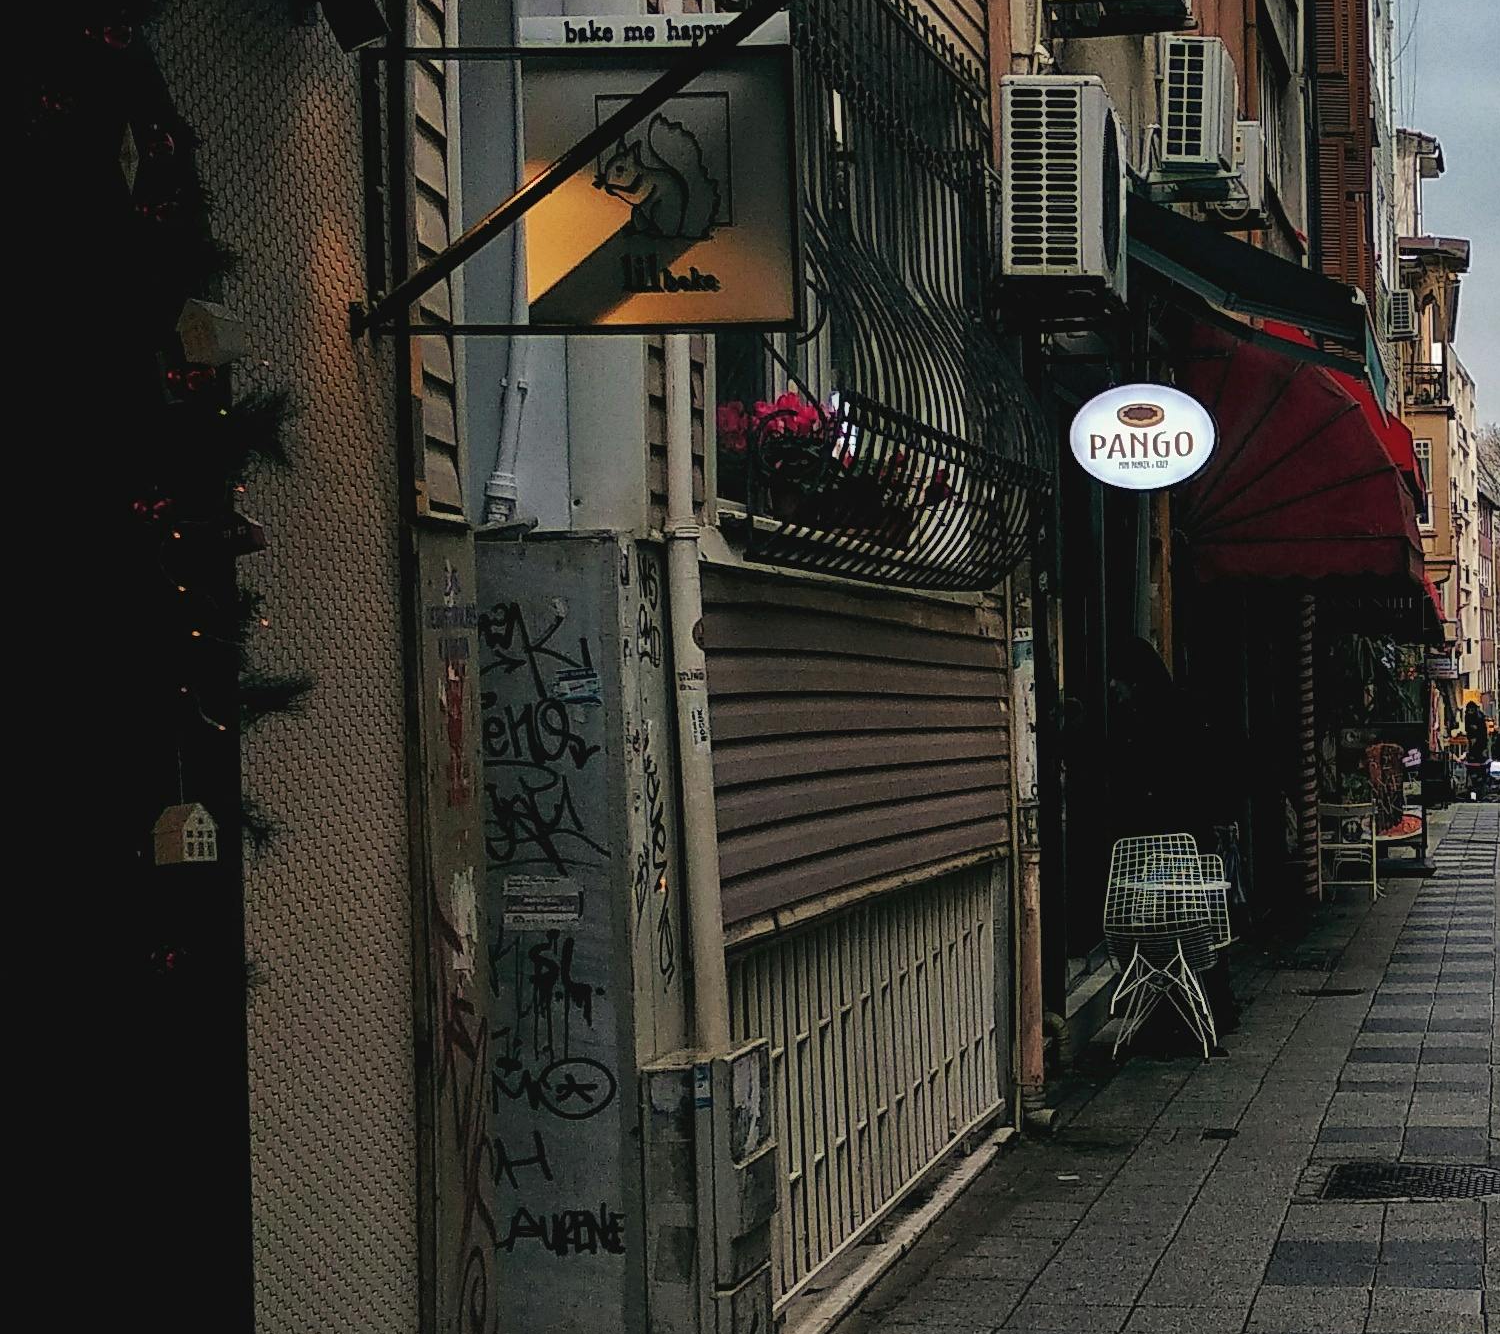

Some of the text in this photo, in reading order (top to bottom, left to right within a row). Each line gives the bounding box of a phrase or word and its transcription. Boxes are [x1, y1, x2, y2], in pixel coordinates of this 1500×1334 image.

[564, 19, 613, 43] bake
[623, 25, 655, 42] me
[1090, 431, 1194, 460] PANGO
